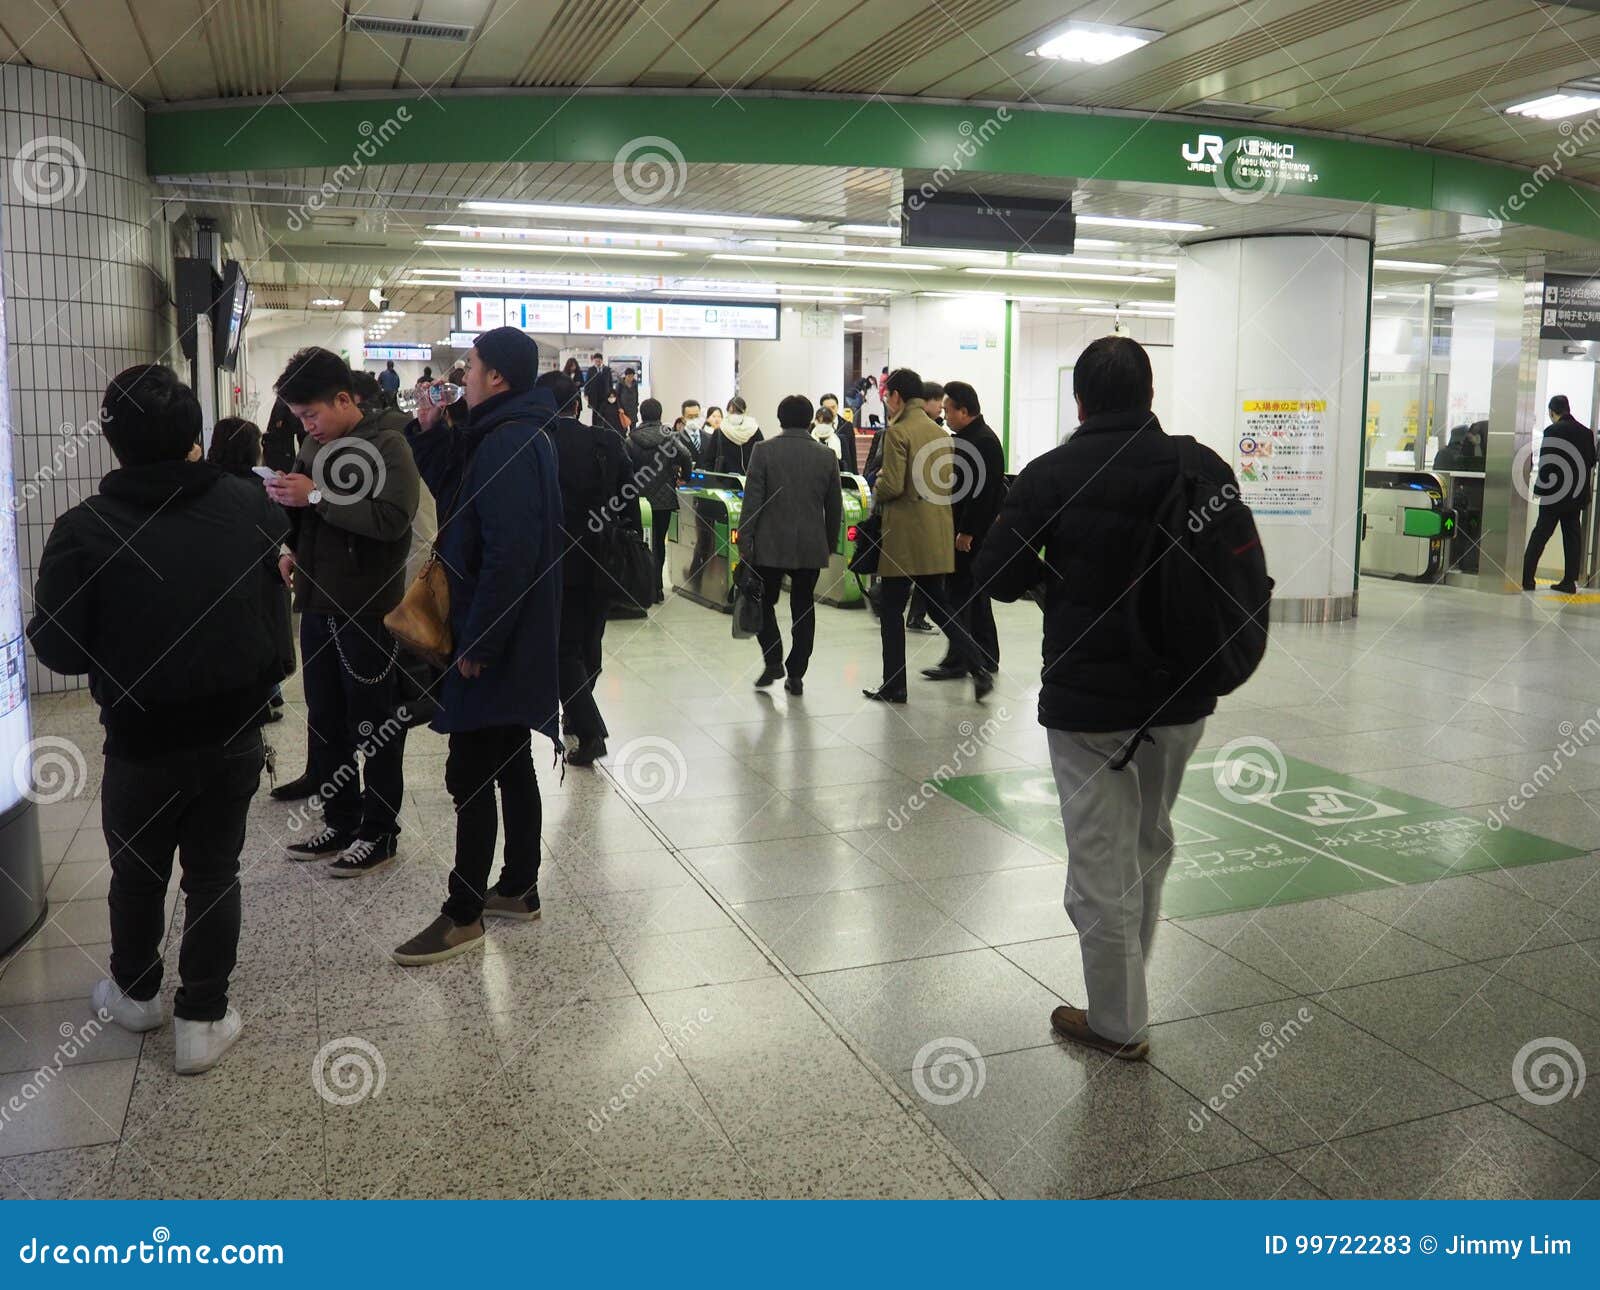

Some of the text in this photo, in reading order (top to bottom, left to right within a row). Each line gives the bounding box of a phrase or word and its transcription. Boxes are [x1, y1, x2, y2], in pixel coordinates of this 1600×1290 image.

[1182, 134, 1223, 163] JR
[1236, 139, 1294, 159] 八重洲北口
[1236, 157, 1310, 172] Yaesu North Entrance
